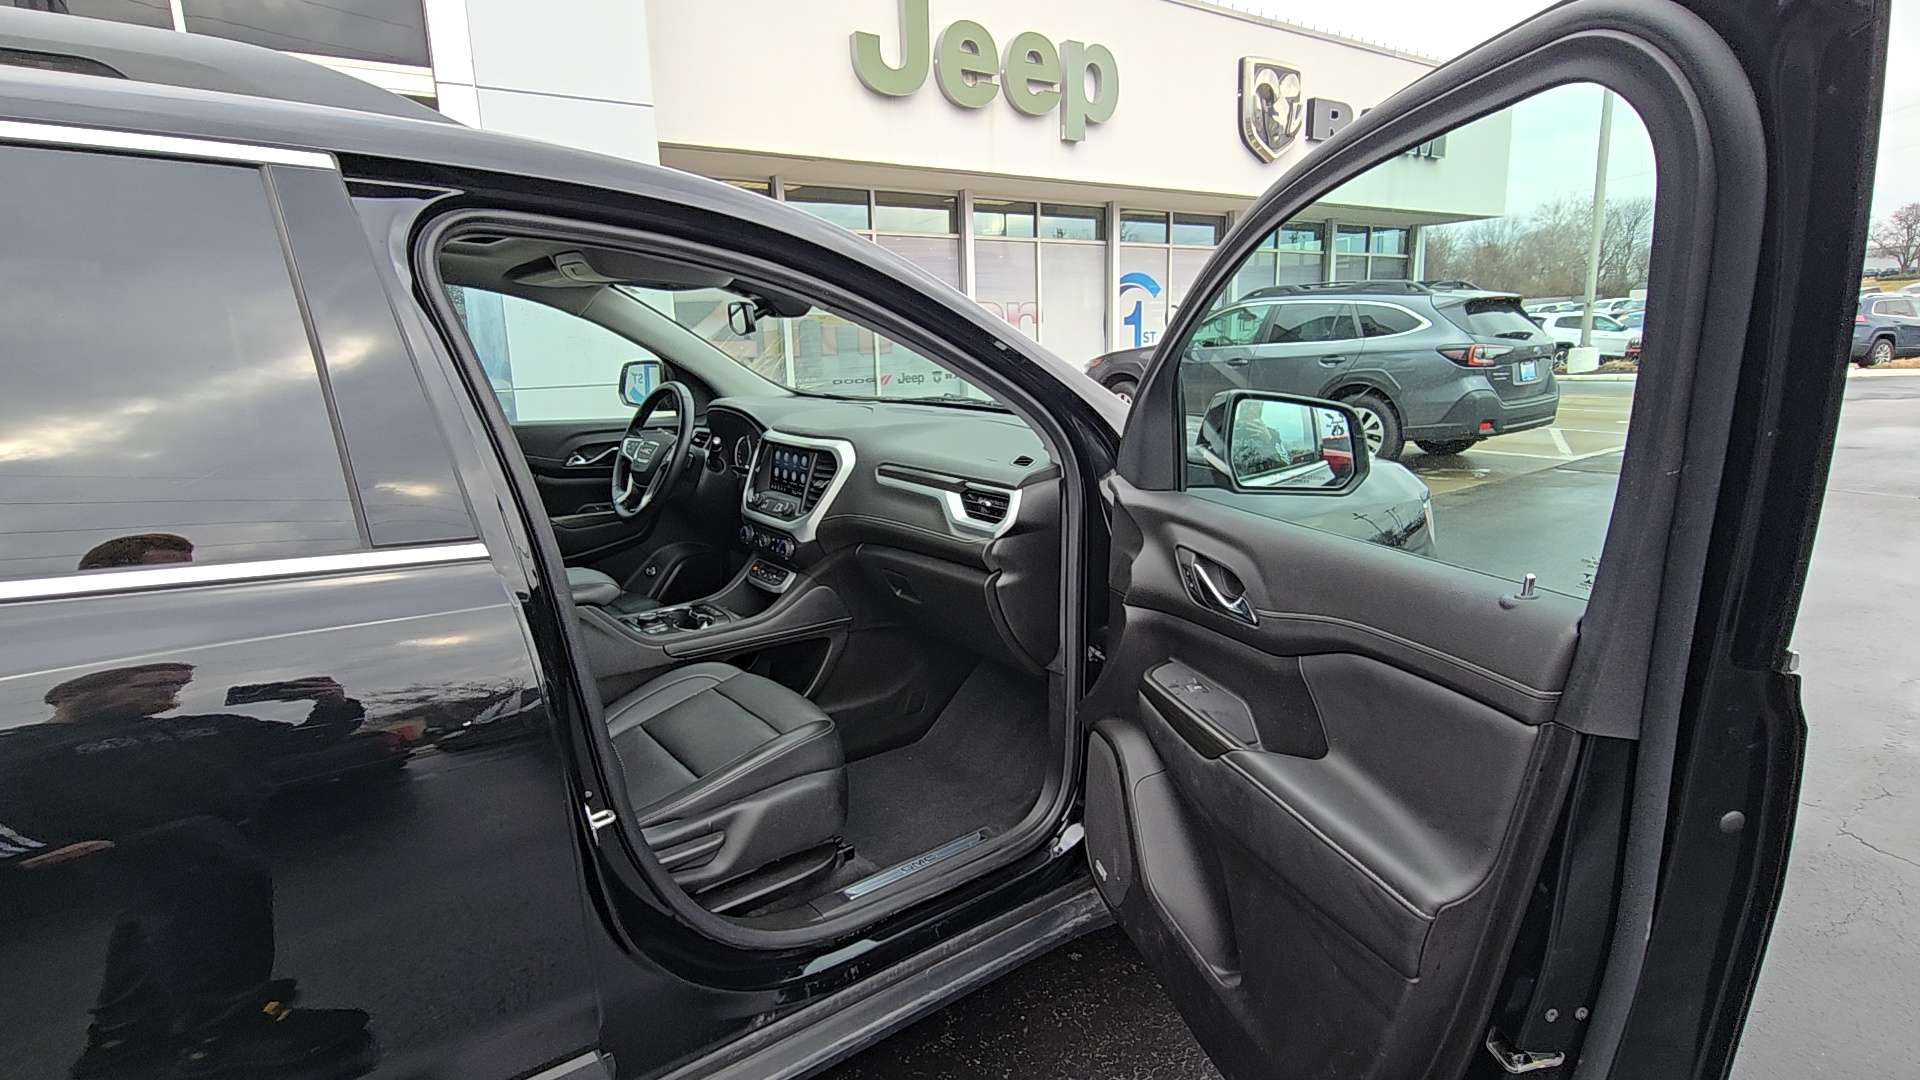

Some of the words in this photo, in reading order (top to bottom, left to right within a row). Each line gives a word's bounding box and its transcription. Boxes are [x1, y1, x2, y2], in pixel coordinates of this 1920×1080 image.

[849, 0, 1119, 143] Jeep
[832, 377, 876, 385] DODG
[897, 372, 925, 385] Jeep
[900, 854, 938, 873] GMC
